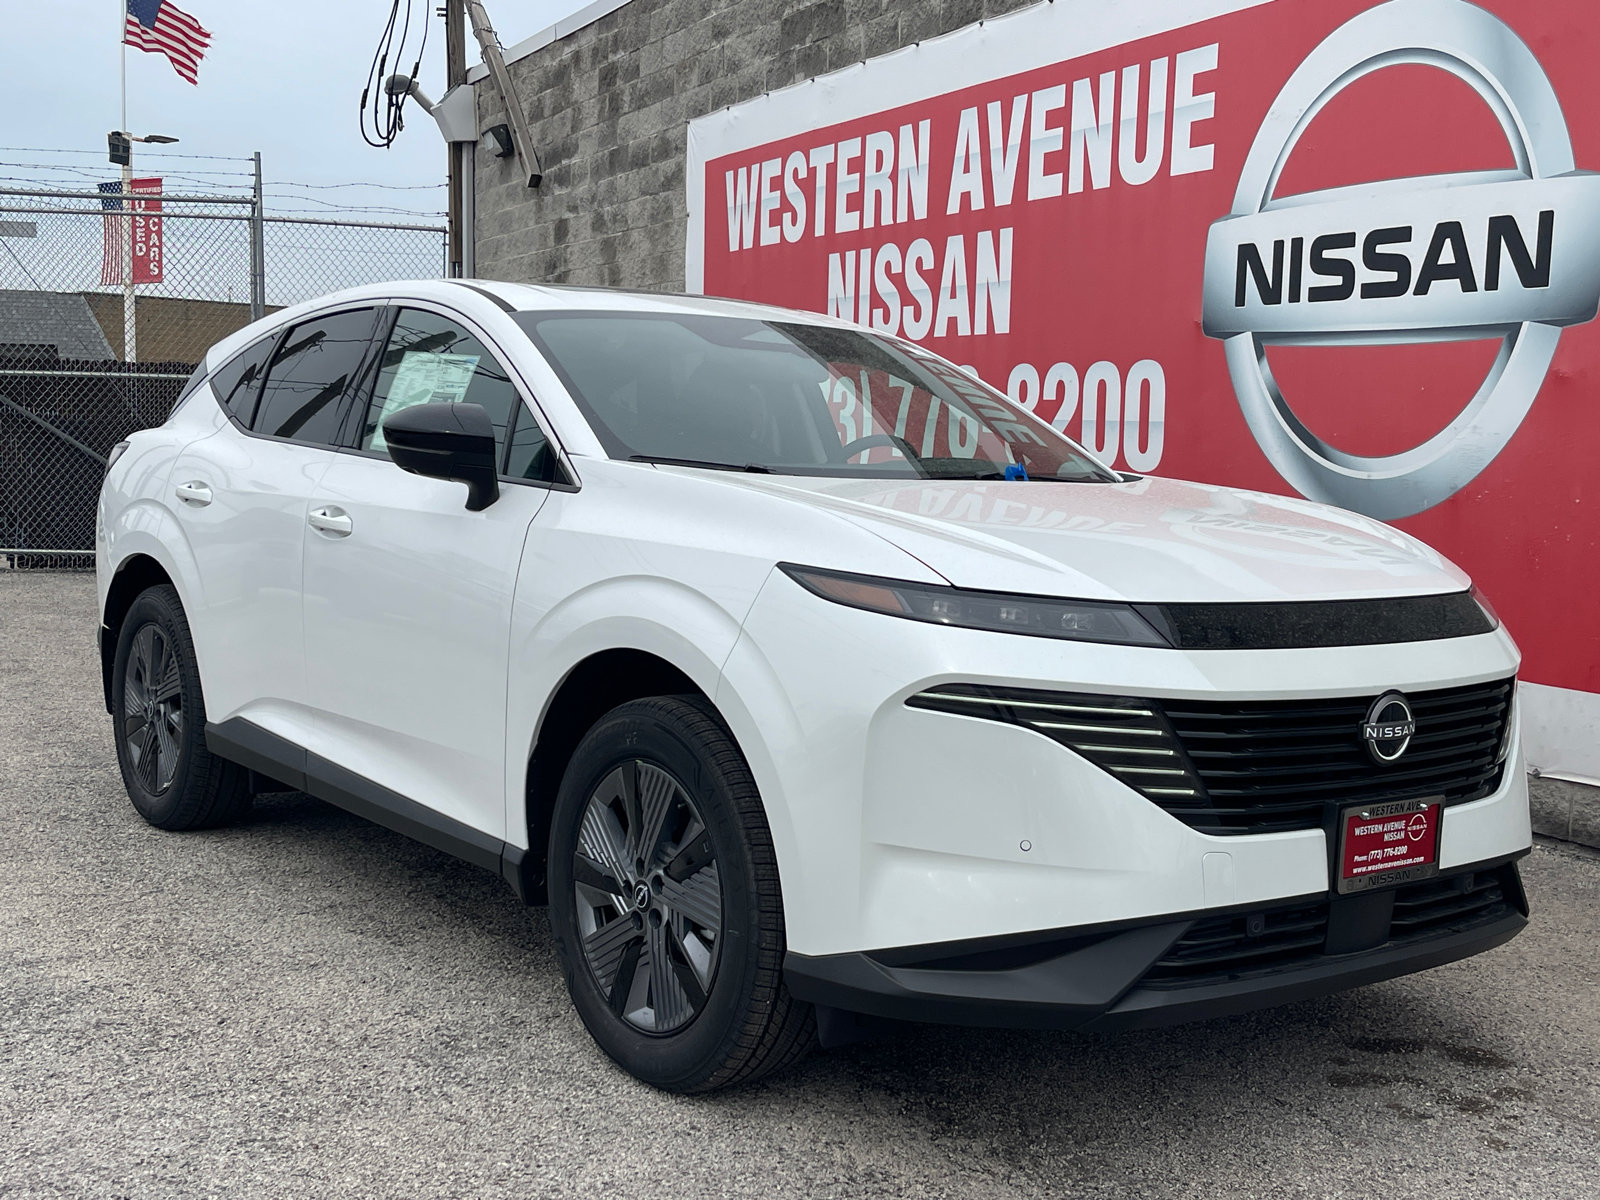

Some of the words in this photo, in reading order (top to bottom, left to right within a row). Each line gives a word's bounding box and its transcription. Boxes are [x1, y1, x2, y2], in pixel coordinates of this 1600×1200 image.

[725, 118, 931, 252] WESTERN
[946, 42, 1219, 215] AVENUE
[135, 200, 146, 256] USED
[149, 218, 159, 275] CARS
[1235, 210, 1554, 308] NISSAN
[827, 227, 1013, 340] NISSAN
[1366, 724, 1415, 738] NISSAN
[1370, 803, 1405, 816] WESTERN
[1355, 825, 1382, 836] WESTERN
[1383, 821, 1405, 832] AVENUE
[1384, 831, 1405, 841] NISSAN
[1368, 849, 1382, 862] (773)
[1384, 846, 1407, 857] 776-8200
[1353, 857, 1424, 873] www.westernavenissan.com
[1369, 870, 1410, 886] NISSAN
